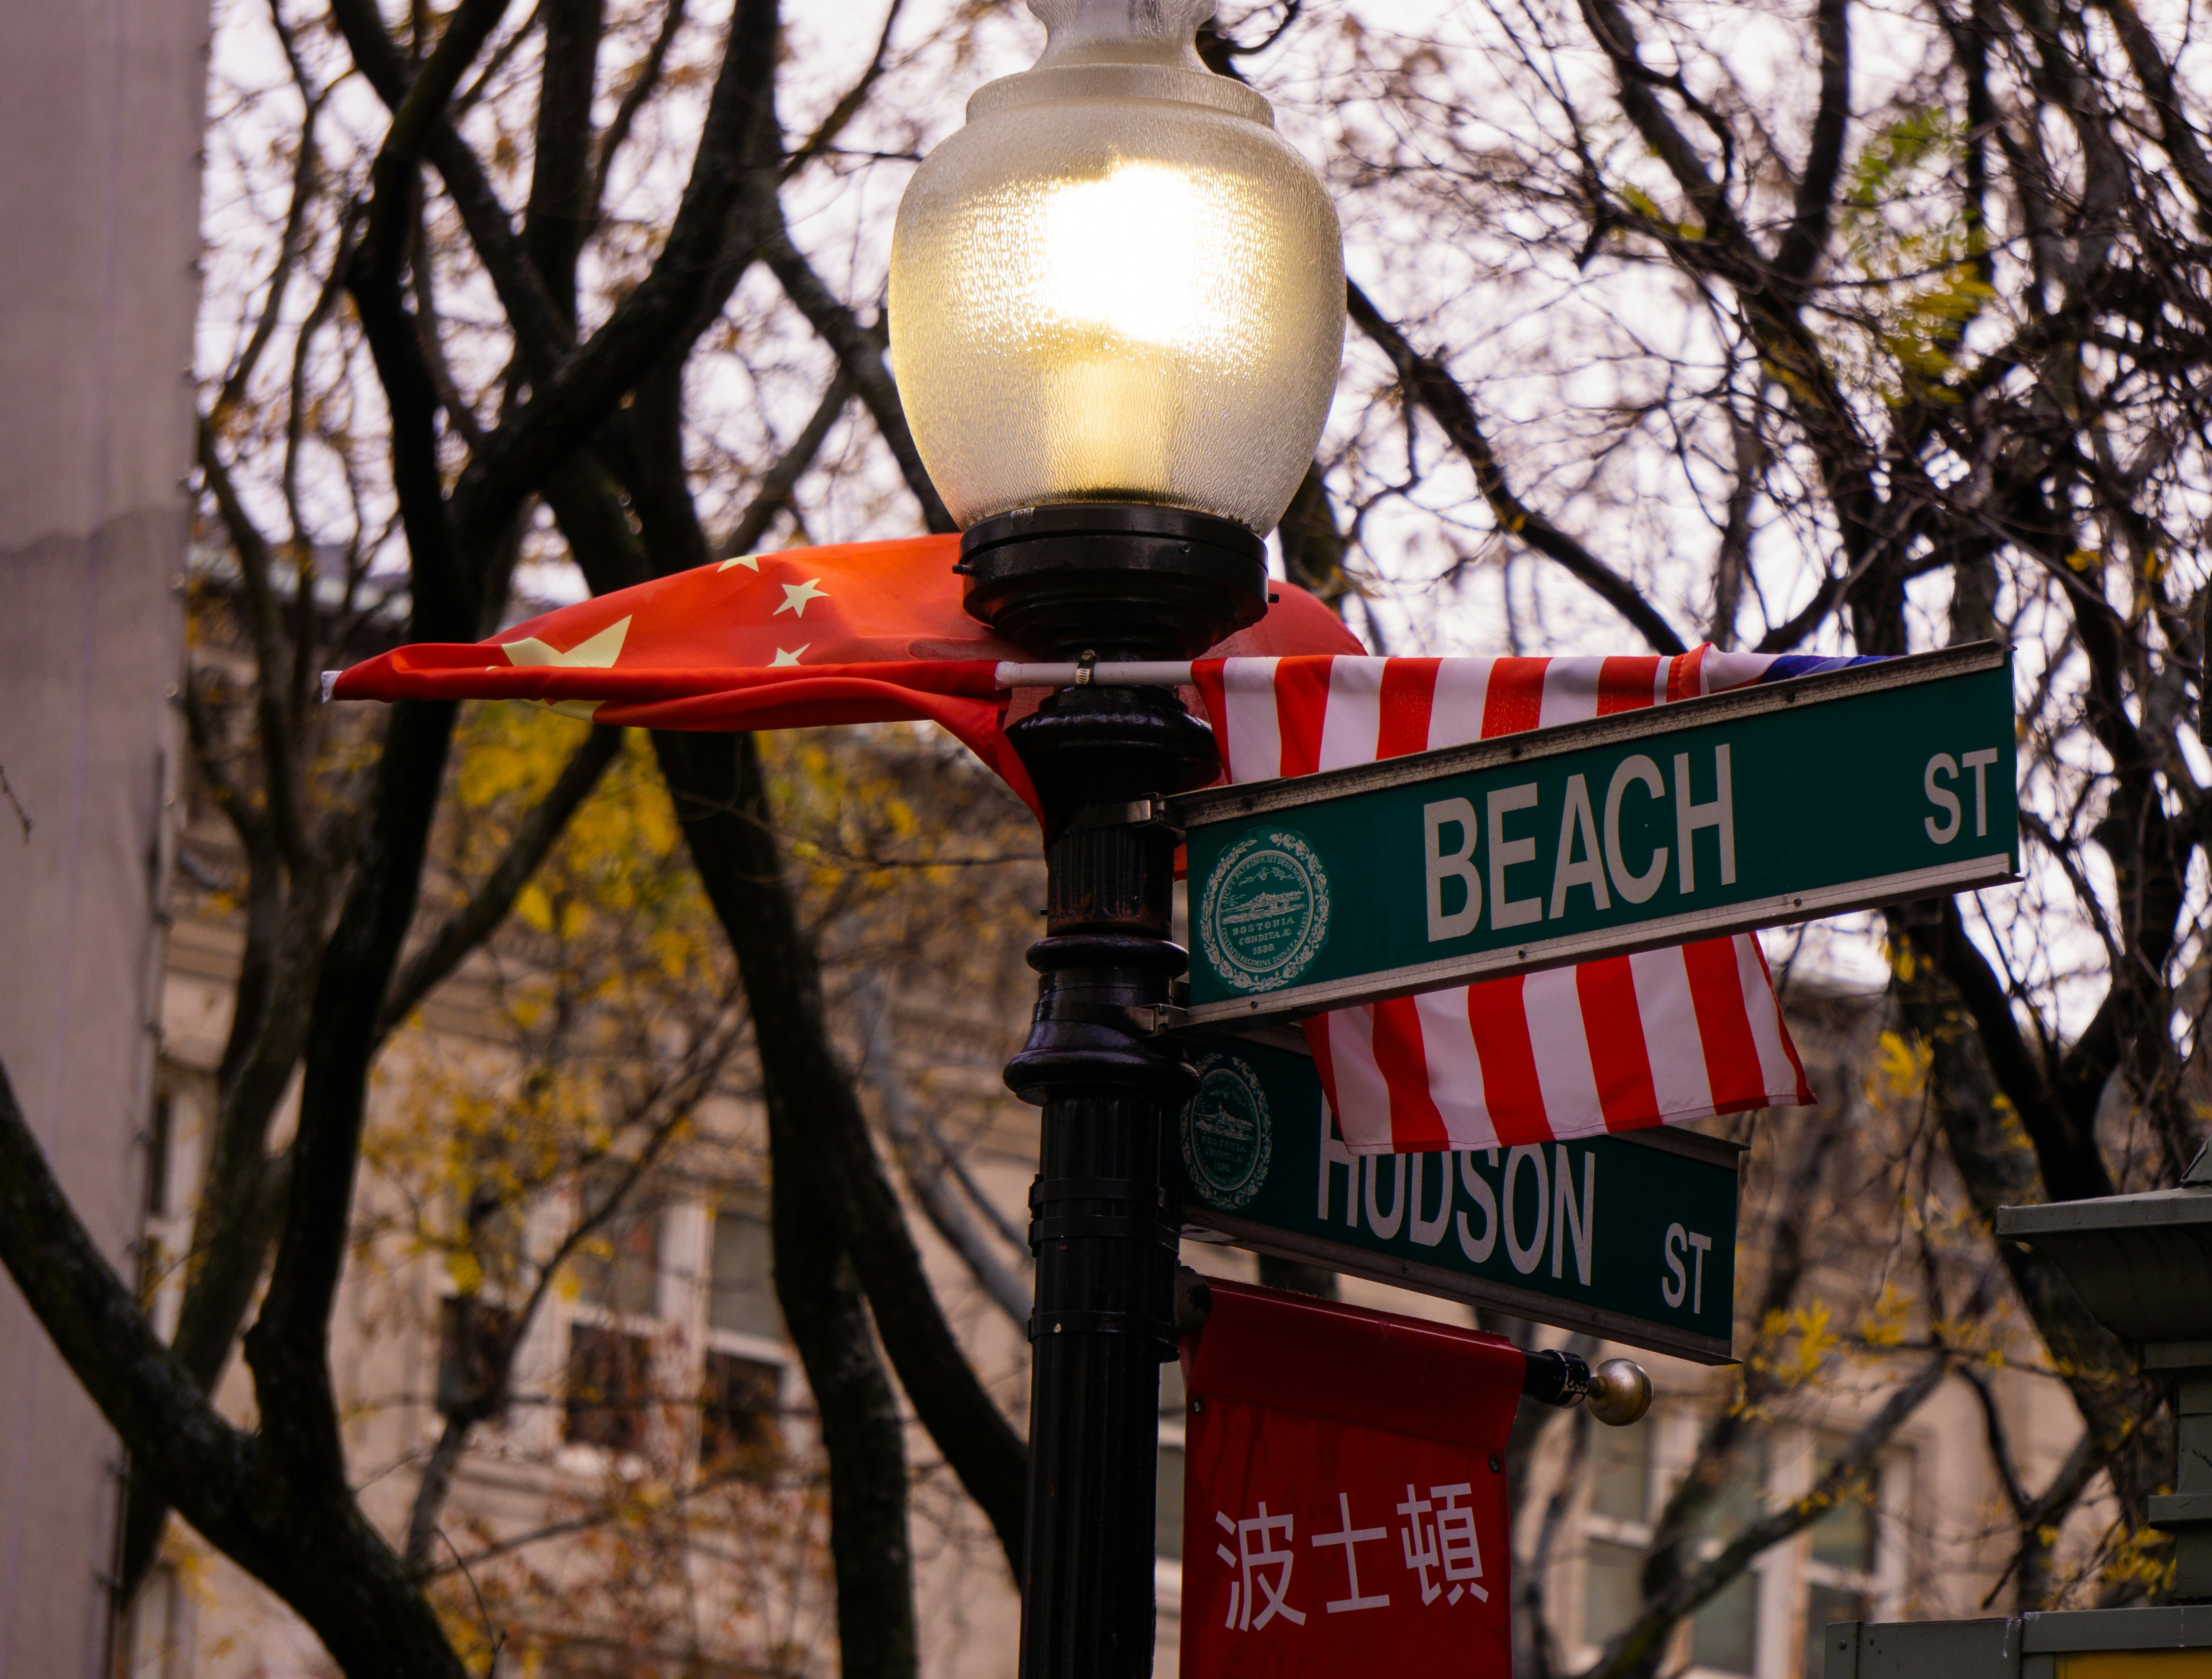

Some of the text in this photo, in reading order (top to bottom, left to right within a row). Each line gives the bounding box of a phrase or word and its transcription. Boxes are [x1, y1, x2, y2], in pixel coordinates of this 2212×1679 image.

[1424, 743, 1998, 942] BEACH ST
[1222, 880, 1236, 904] SICUT
[1278, 856, 1293, 871] DEUS
[1293, 868, 1306, 889] NOBIS
[1233, 917, 1295, 935] BOSTONIA
[1239, 931, 1281, 945] CONDITA
[1240, 955, 1272, 967] REGIMINE
[1318, 1088, 1712, 1314] HUDSON ST
[1215, 1482, 1489, 1632] 波士頓
